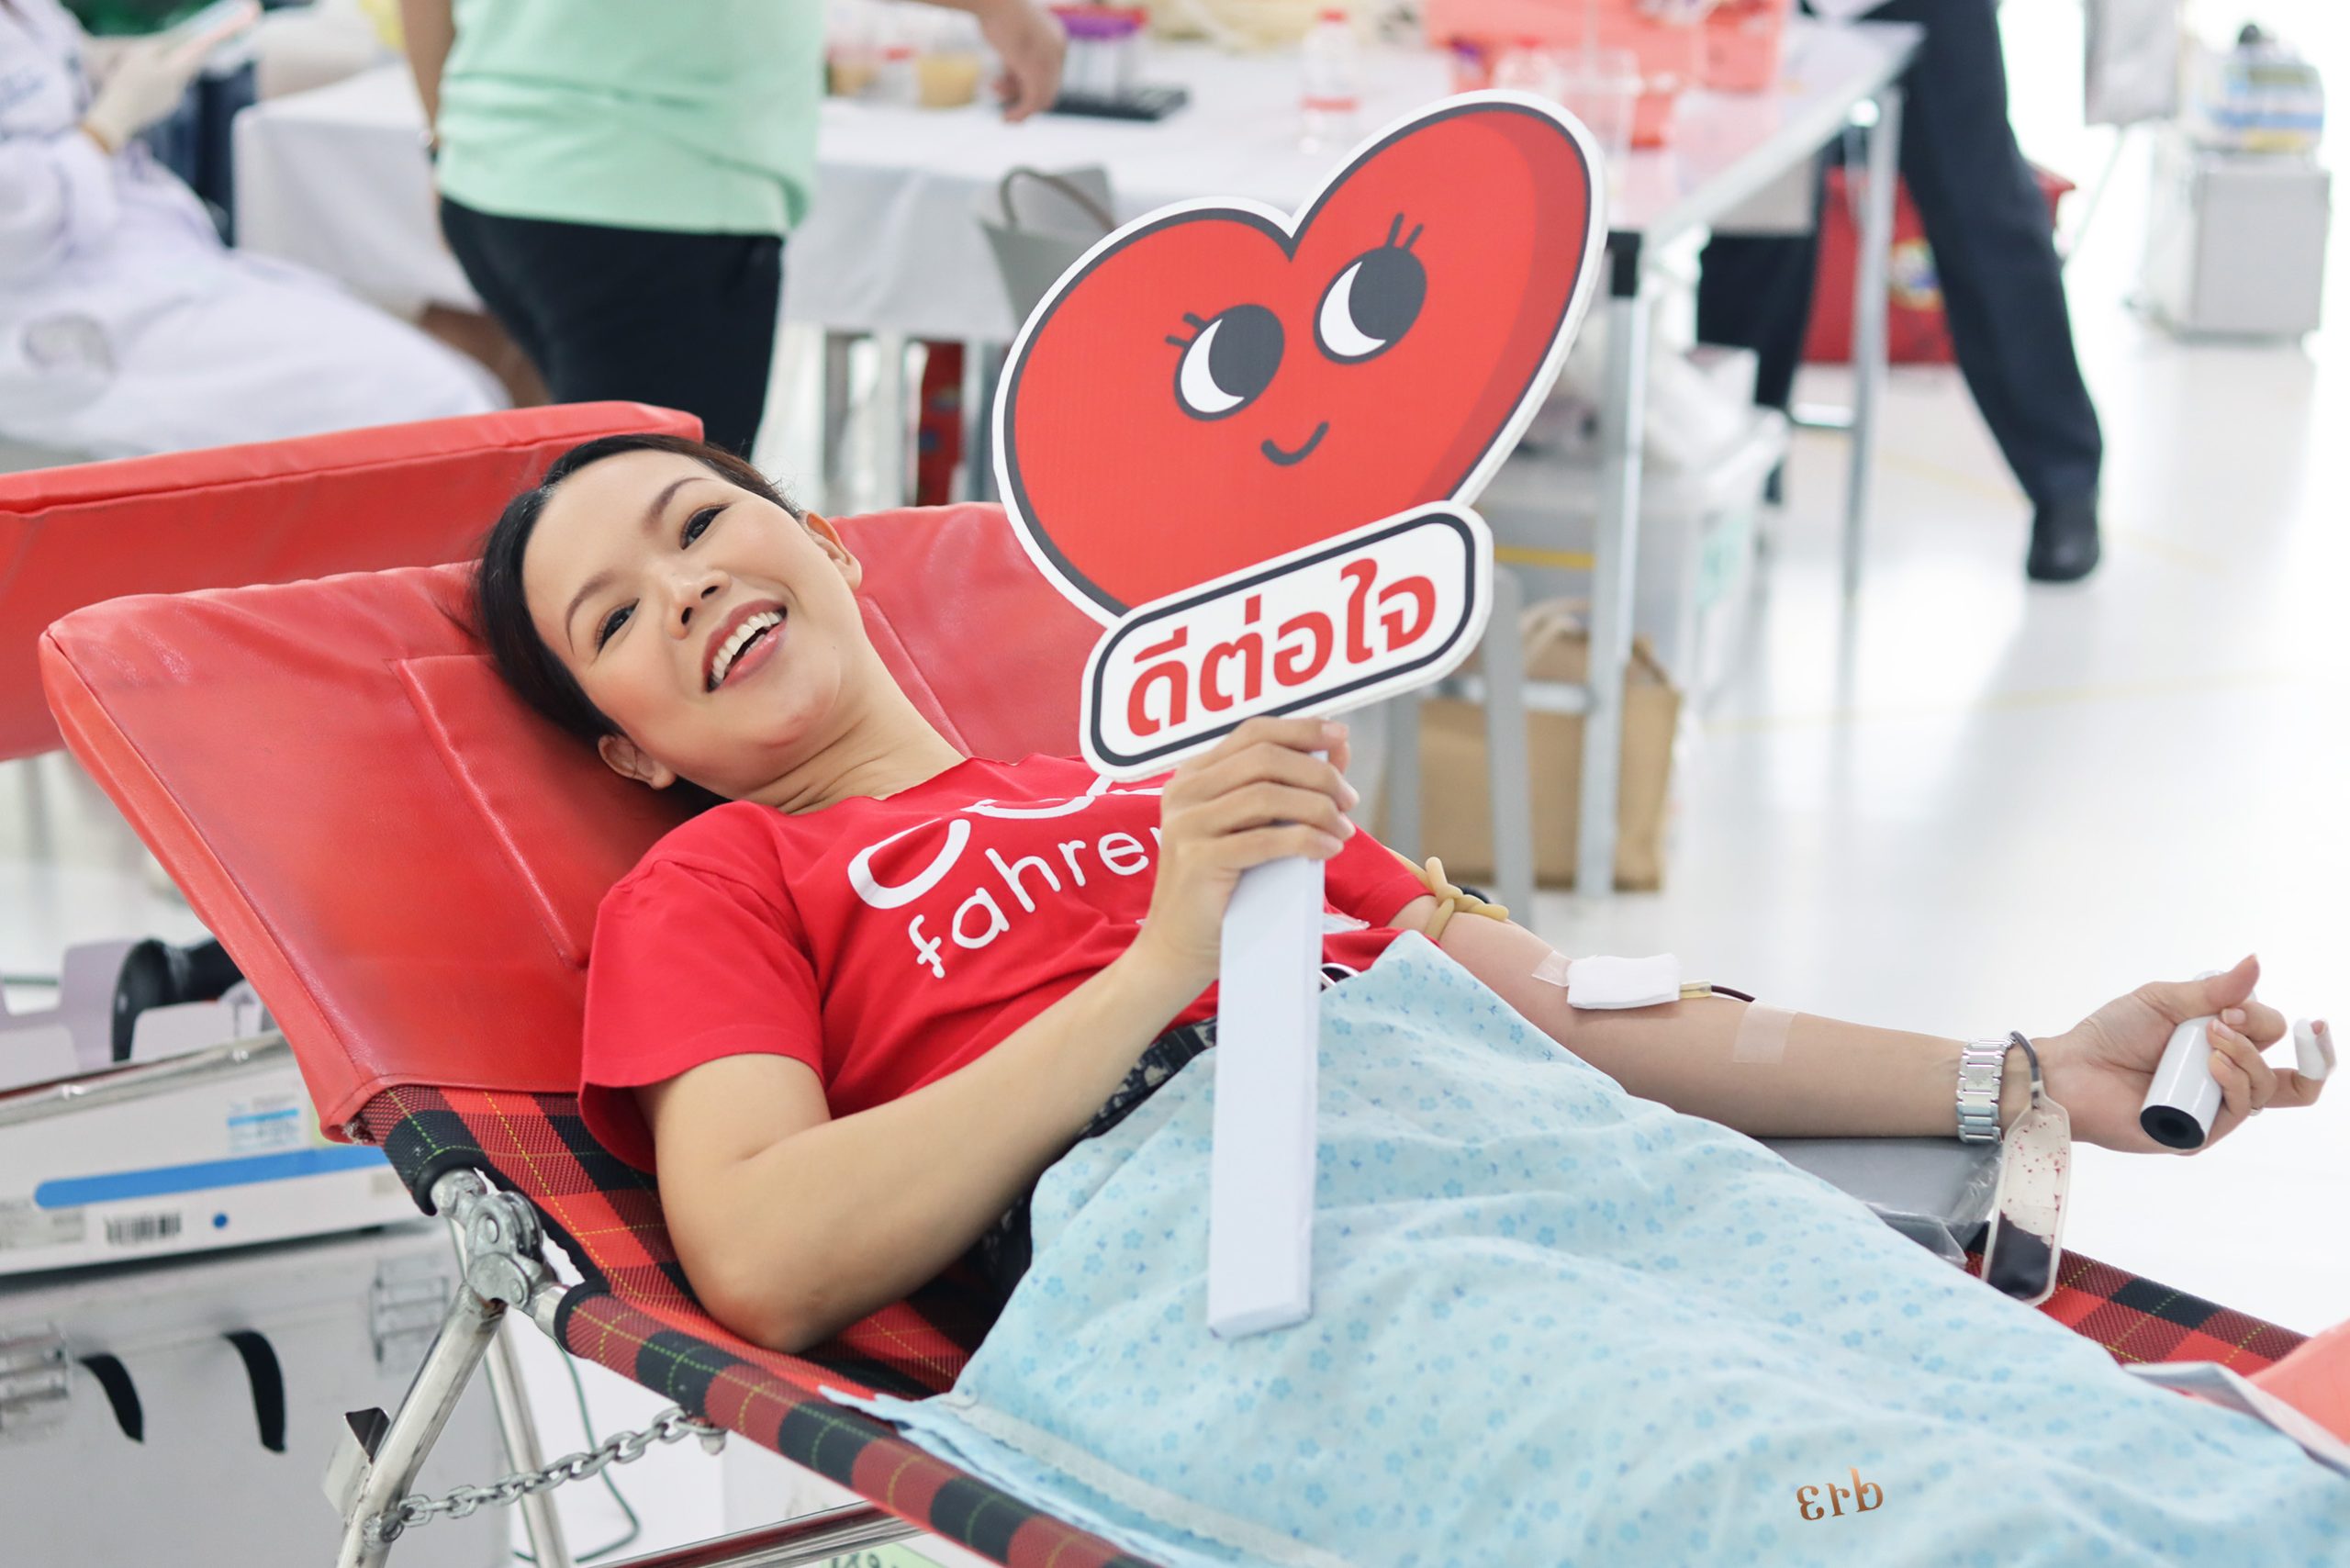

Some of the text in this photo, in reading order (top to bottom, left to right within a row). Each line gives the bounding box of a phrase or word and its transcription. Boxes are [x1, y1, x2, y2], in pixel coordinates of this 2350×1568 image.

[1126, 557, 1437, 737] ดีต่อใจ
[908, 826, 1161, 979] fahre
